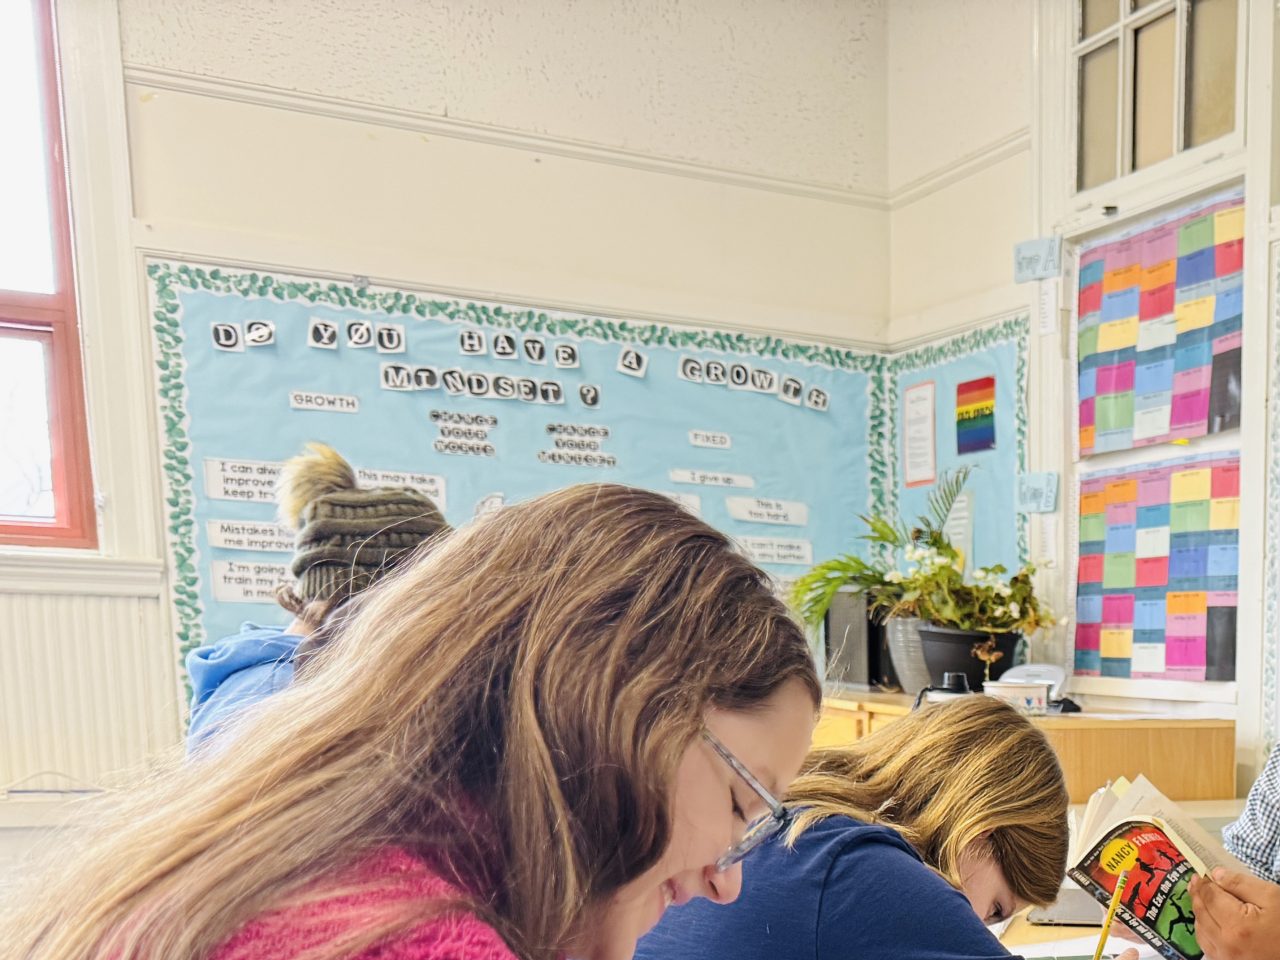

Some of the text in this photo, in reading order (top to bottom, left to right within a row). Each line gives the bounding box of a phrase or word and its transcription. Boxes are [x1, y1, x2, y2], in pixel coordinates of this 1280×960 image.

[312, 321, 401, 350] YOU
[461, 331, 578, 366] HAVE
[621, 350, 643, 371] A
[682, 358, 827, 408] GROWTH
[384, 365, 562, 402] MINDSET
[293, 393, 356, 409] GROWTH
[693, 432, 727, 445] FIXED
[220, 461, 227, 472] I
[230, 464, 253, 473] can
[223, 475, 275, 487] improve
[358, 469, 437, 485] This may take
[690, 472, 697, 481] I
[699, 474, 719, 484] give
[223, 487, 255, 499] keep
[756, 499, 773, 510] This
[220, 524, 275, 536] Mistakes
[224, 538, 244, 546] me
[228, 561, 286, 575] I'm going
[223, 575, 252, 585] train
[255, 578, 274, 586] my
[243, 587, 253, 597] in
[1105, 842, 1135, 872] NANCY
[1072, 869, 1091, 887] FARMER
[1145, 909, 1159, 921] The
[1160, 880, 1172, 893] the
[1166, 870, 1181, 883] Eye
[1176, 863, 1188, 874] and
